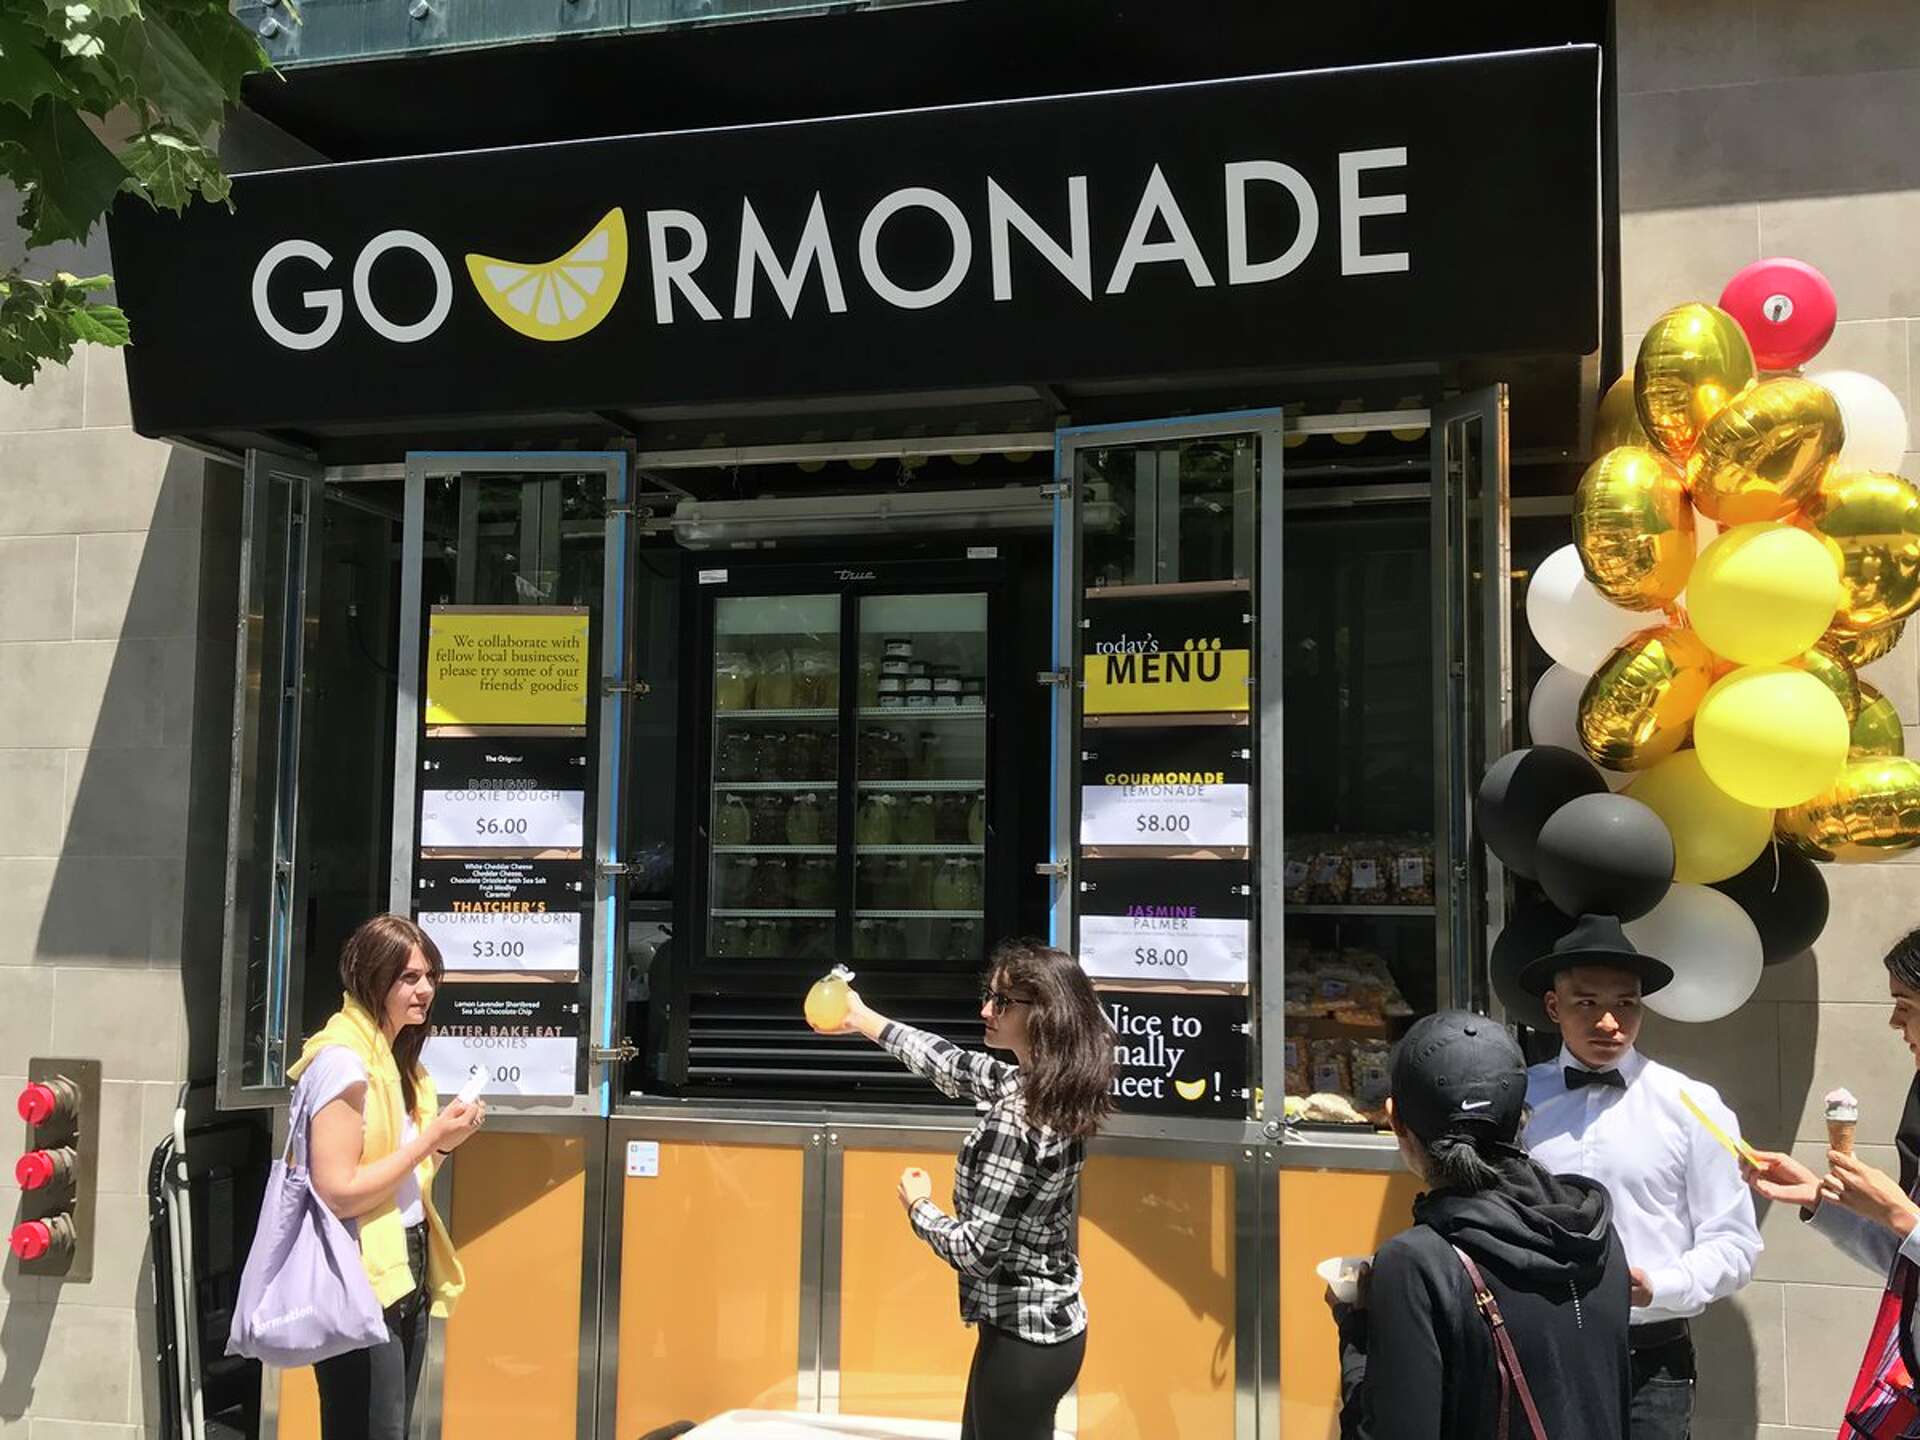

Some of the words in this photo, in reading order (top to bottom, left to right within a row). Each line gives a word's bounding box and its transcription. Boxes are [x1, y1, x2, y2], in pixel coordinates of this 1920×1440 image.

[454, 633, 475, 647] We
[478, 633, 548, 648] collaborate
[551, 635, 580, 649] with
[1096, 633, 1159, 654] today's
[436, 648, 475, 662] fellow
[478, 649, 507, 662] local
[512, 650, 580, 663] businesses,
[440, 664, 477, 679] please
[481, 667, 498, 679] try
[503, 667, 537, 677] some
[540, 664, 554, 677] of
[556, 667, 579, 677] our
[480, 677, 526, 691] friends'
[530, 679, 579, 695] goodies
[1105, 772, 1225, 785] GOURMONADE
[445, 791, 501, 801] COOKIE
[507, 791, 561, 801] DOUGH
[1122, 784, 1205, 797] LEMONADE
[476, 818, 528, 835] $6.00
[1136, 814, 1190, 832] $8.00
[523, 877, 534, 885] Sea
[535, 877, 546, 885] Salt
[452, 901, 546, 912] THATCHER'S
[1126, 905, 1198, 918] JASMINE
[425, 913, 496, 924] GOURMET
[502, 913, 572, 925] POPCORN
[1134, 918, 1189, 930] PALMER
[473, 940, 524, 957] $3.00
[1135, 946, 1188, 966] $8.00
[518, 1008, 533, 1016] Chip
[1097, 1004, 1162, 1036] Nice
[1171, 1015, 1202, 1038] to
[463, 1037, 528, 1048] COOKIES
[1113, 1035, 1185, 1078] nally
[470, 1064, 521, 1082] $.00
